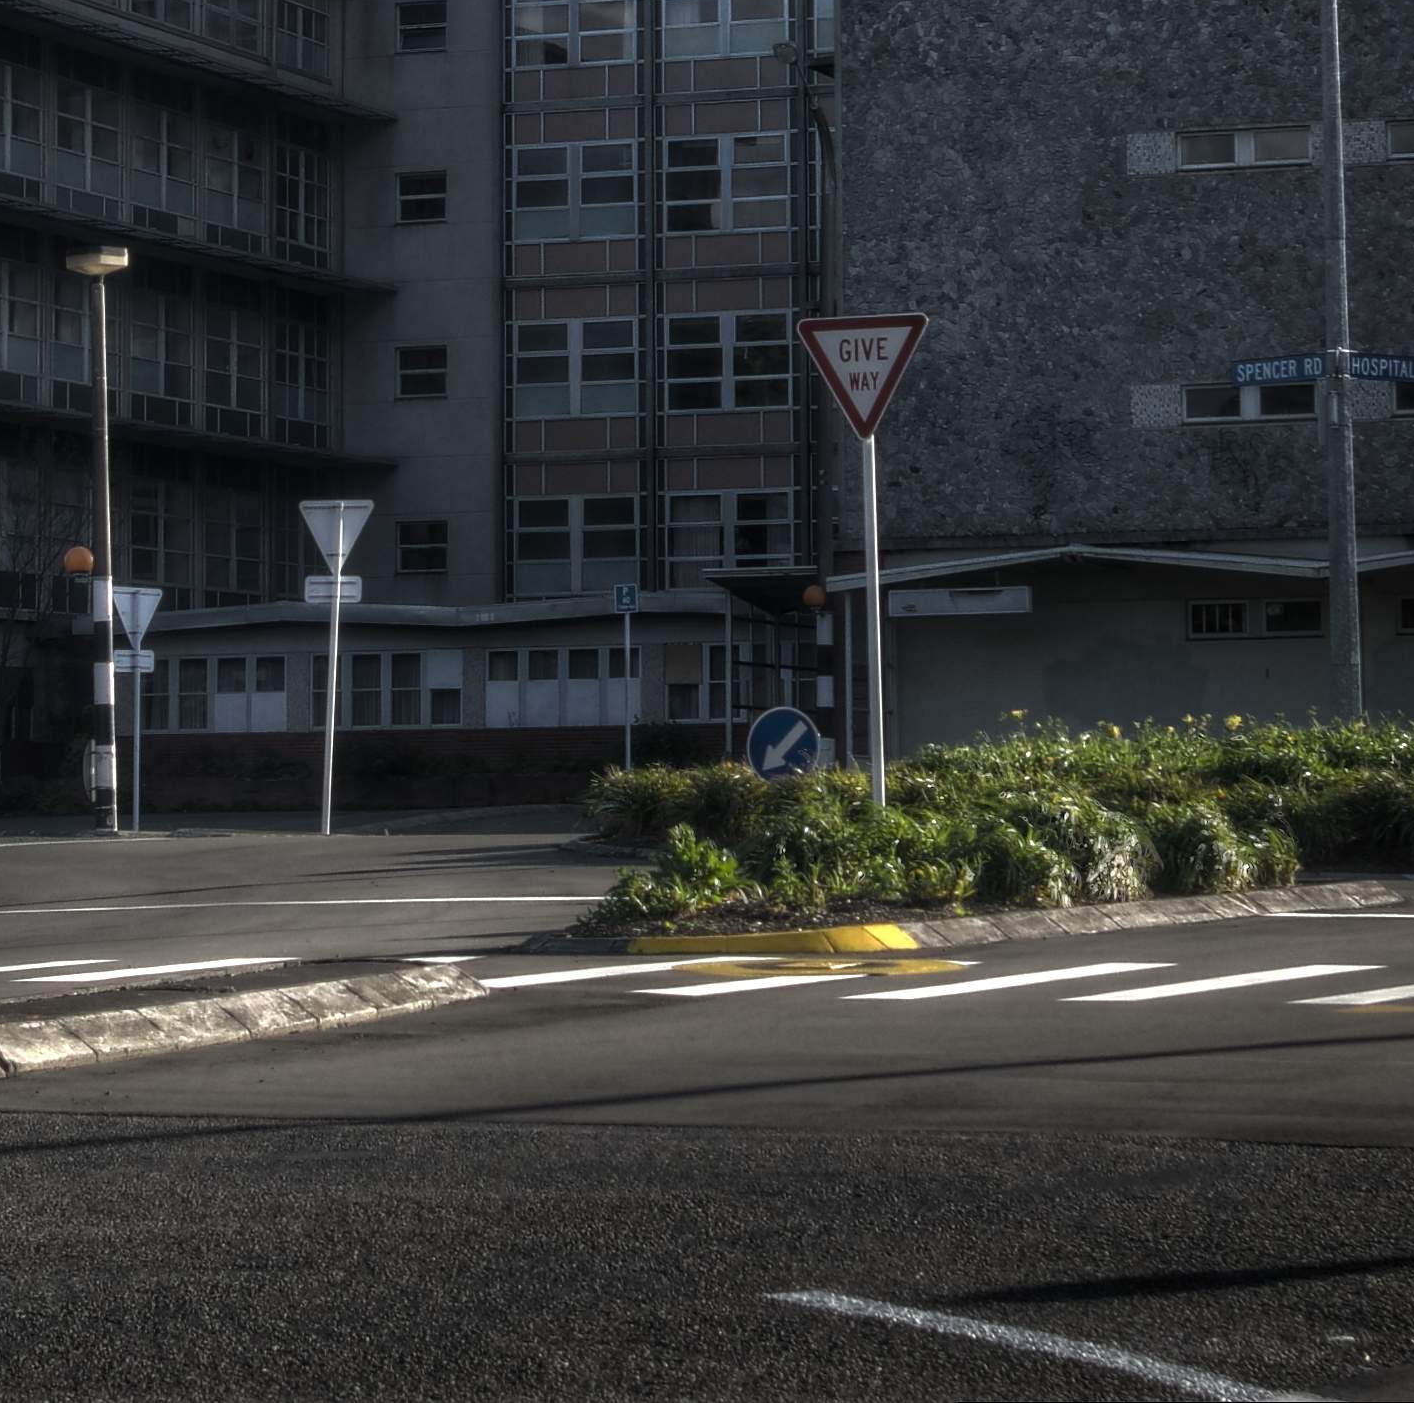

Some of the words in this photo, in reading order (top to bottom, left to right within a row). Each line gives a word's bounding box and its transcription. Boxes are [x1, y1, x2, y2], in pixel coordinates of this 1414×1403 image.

[839, 337, 889, 362] GIVE
[850, 372, 879, 391] WAY
[1236, 358, 1297, 382] SPENCER
[1304, 357, 1323, 376] RD
